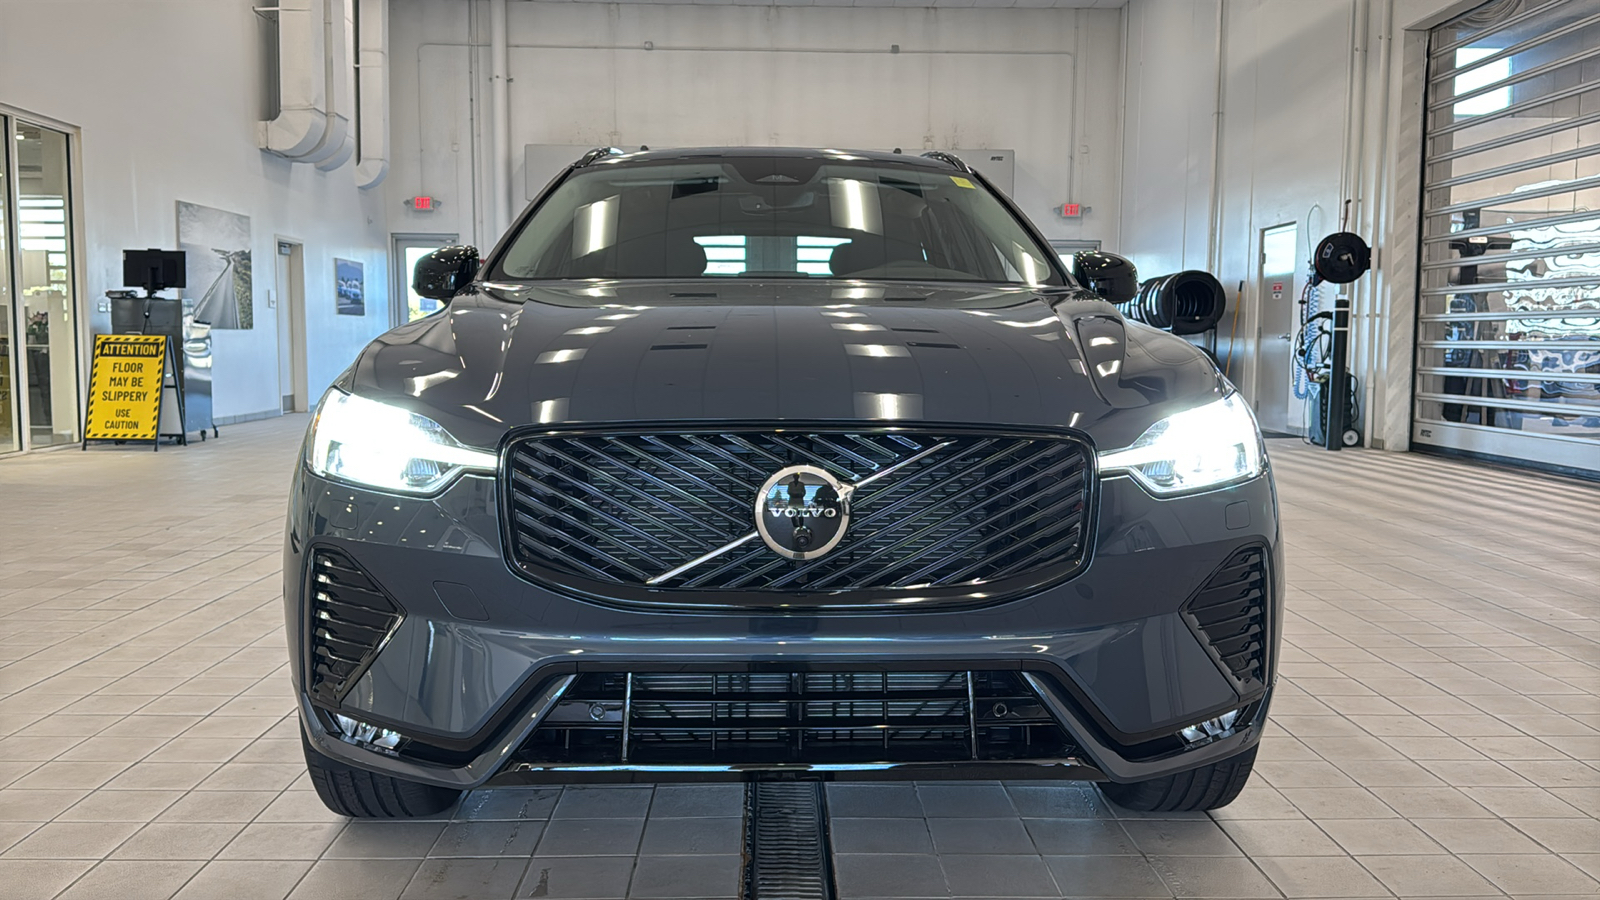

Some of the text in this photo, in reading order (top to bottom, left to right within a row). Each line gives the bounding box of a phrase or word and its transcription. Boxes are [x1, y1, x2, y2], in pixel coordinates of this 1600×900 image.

[415, 196, 431, 209] EXIT
[1064, 203, 1080, 215] EXIT
[102, 344, 157, 356] ATTENTION
[112, 362, 144, 373] FLOOR
[109, 377, 144, 388] MAY BE
[102, 391, 148, 402] SLIPPERY
[115, 409, 131, 418] USE
[104, 421, 140, 430] CAUTION
[768, 507, 837, 518] VOLVO
